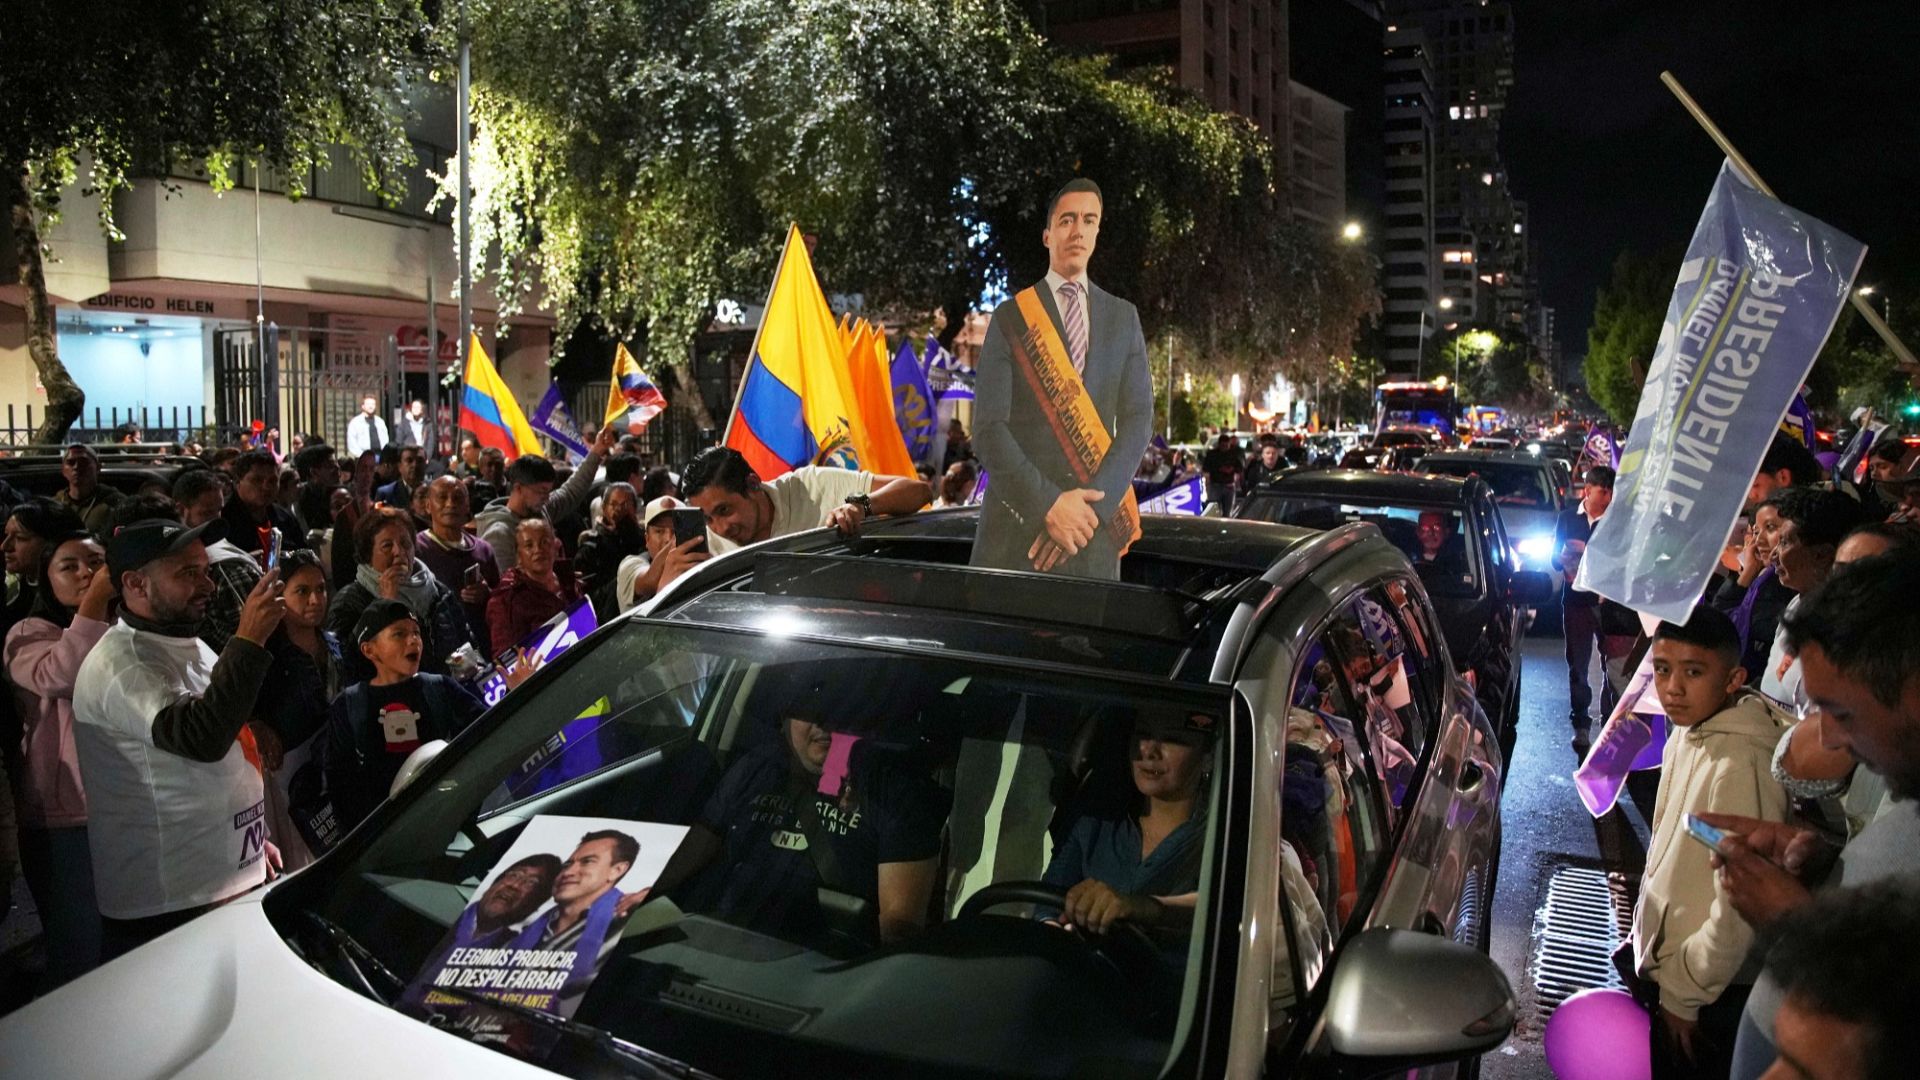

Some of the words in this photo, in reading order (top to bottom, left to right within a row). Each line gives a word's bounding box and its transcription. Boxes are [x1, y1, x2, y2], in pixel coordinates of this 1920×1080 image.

[88, 295, 155, 309] EDIFICIO
[166, 298, 214, 312] HELEN
[779, 834, 801, 847] NY
[446, 948, 513, 967] ELEGIMOS
[508, 949, 578, 970] PRODUCIR,
[434, 968, 456, 987] NO
[455, 968, 569, 990] DESPILFARRAR
